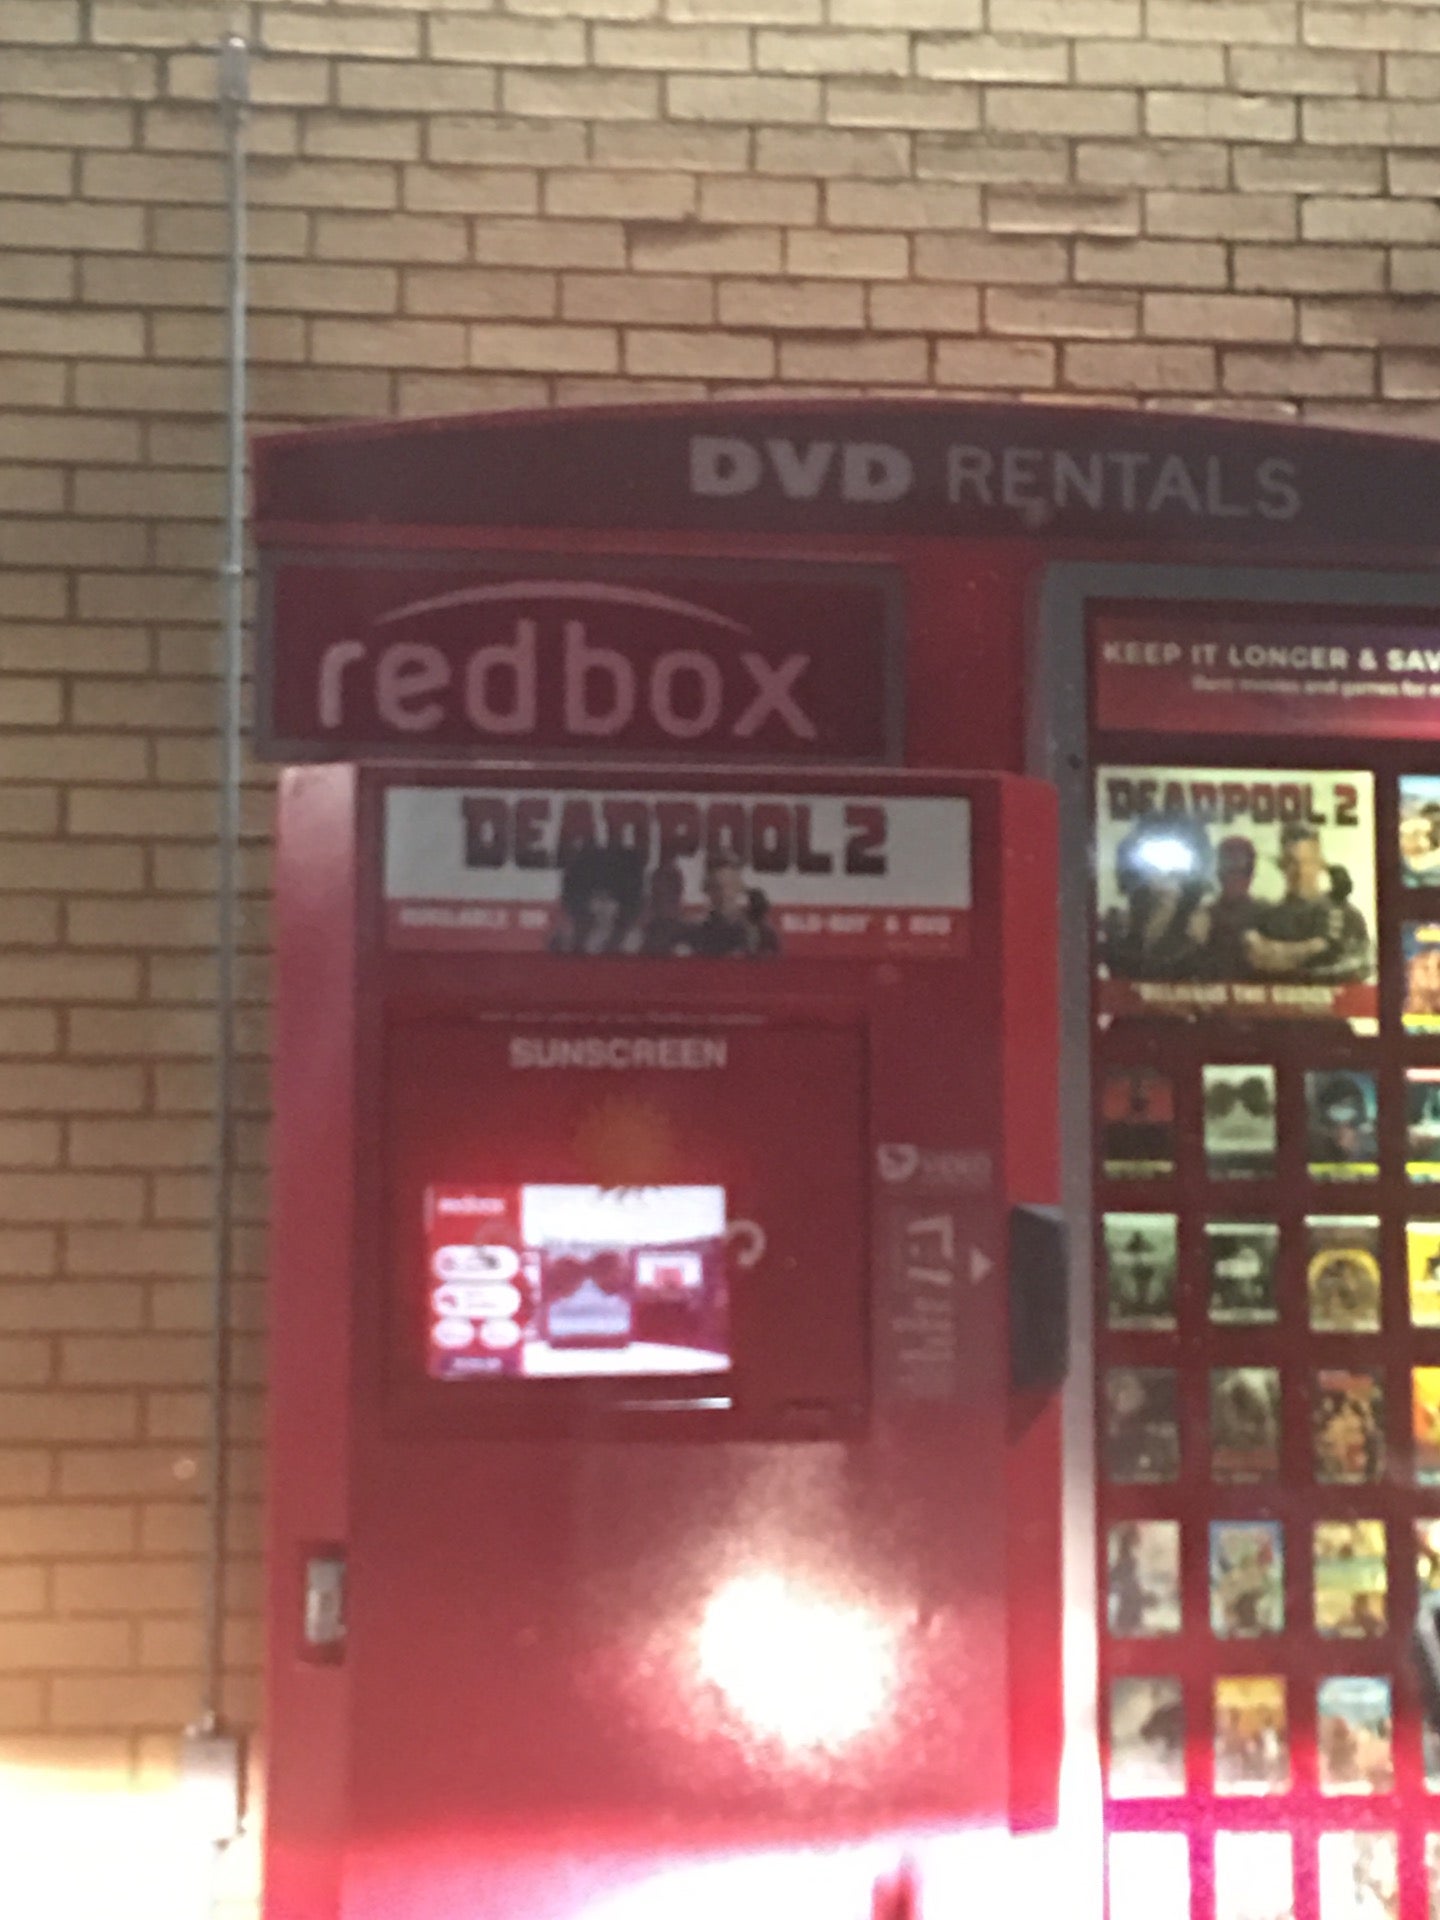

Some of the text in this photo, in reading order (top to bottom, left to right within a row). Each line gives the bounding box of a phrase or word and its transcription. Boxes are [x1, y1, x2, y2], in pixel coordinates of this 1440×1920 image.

[687, 434, 1301, 520] DVD RENTALS
[317, 617, 818, 740] redbox
[1102, 641, 1182, 666] KEEP
[1191, 643, 1219, 667] IT
[1228, 645, 1349, 671] LONGER
[1358, 647, 1379, 672] &
[1107, 777, 1359, 826] DEADPOOL 2
[461, 796, 888, 876] DEADPOOL 2
[509, 1036, 729, 1069] SUNSCREEN
